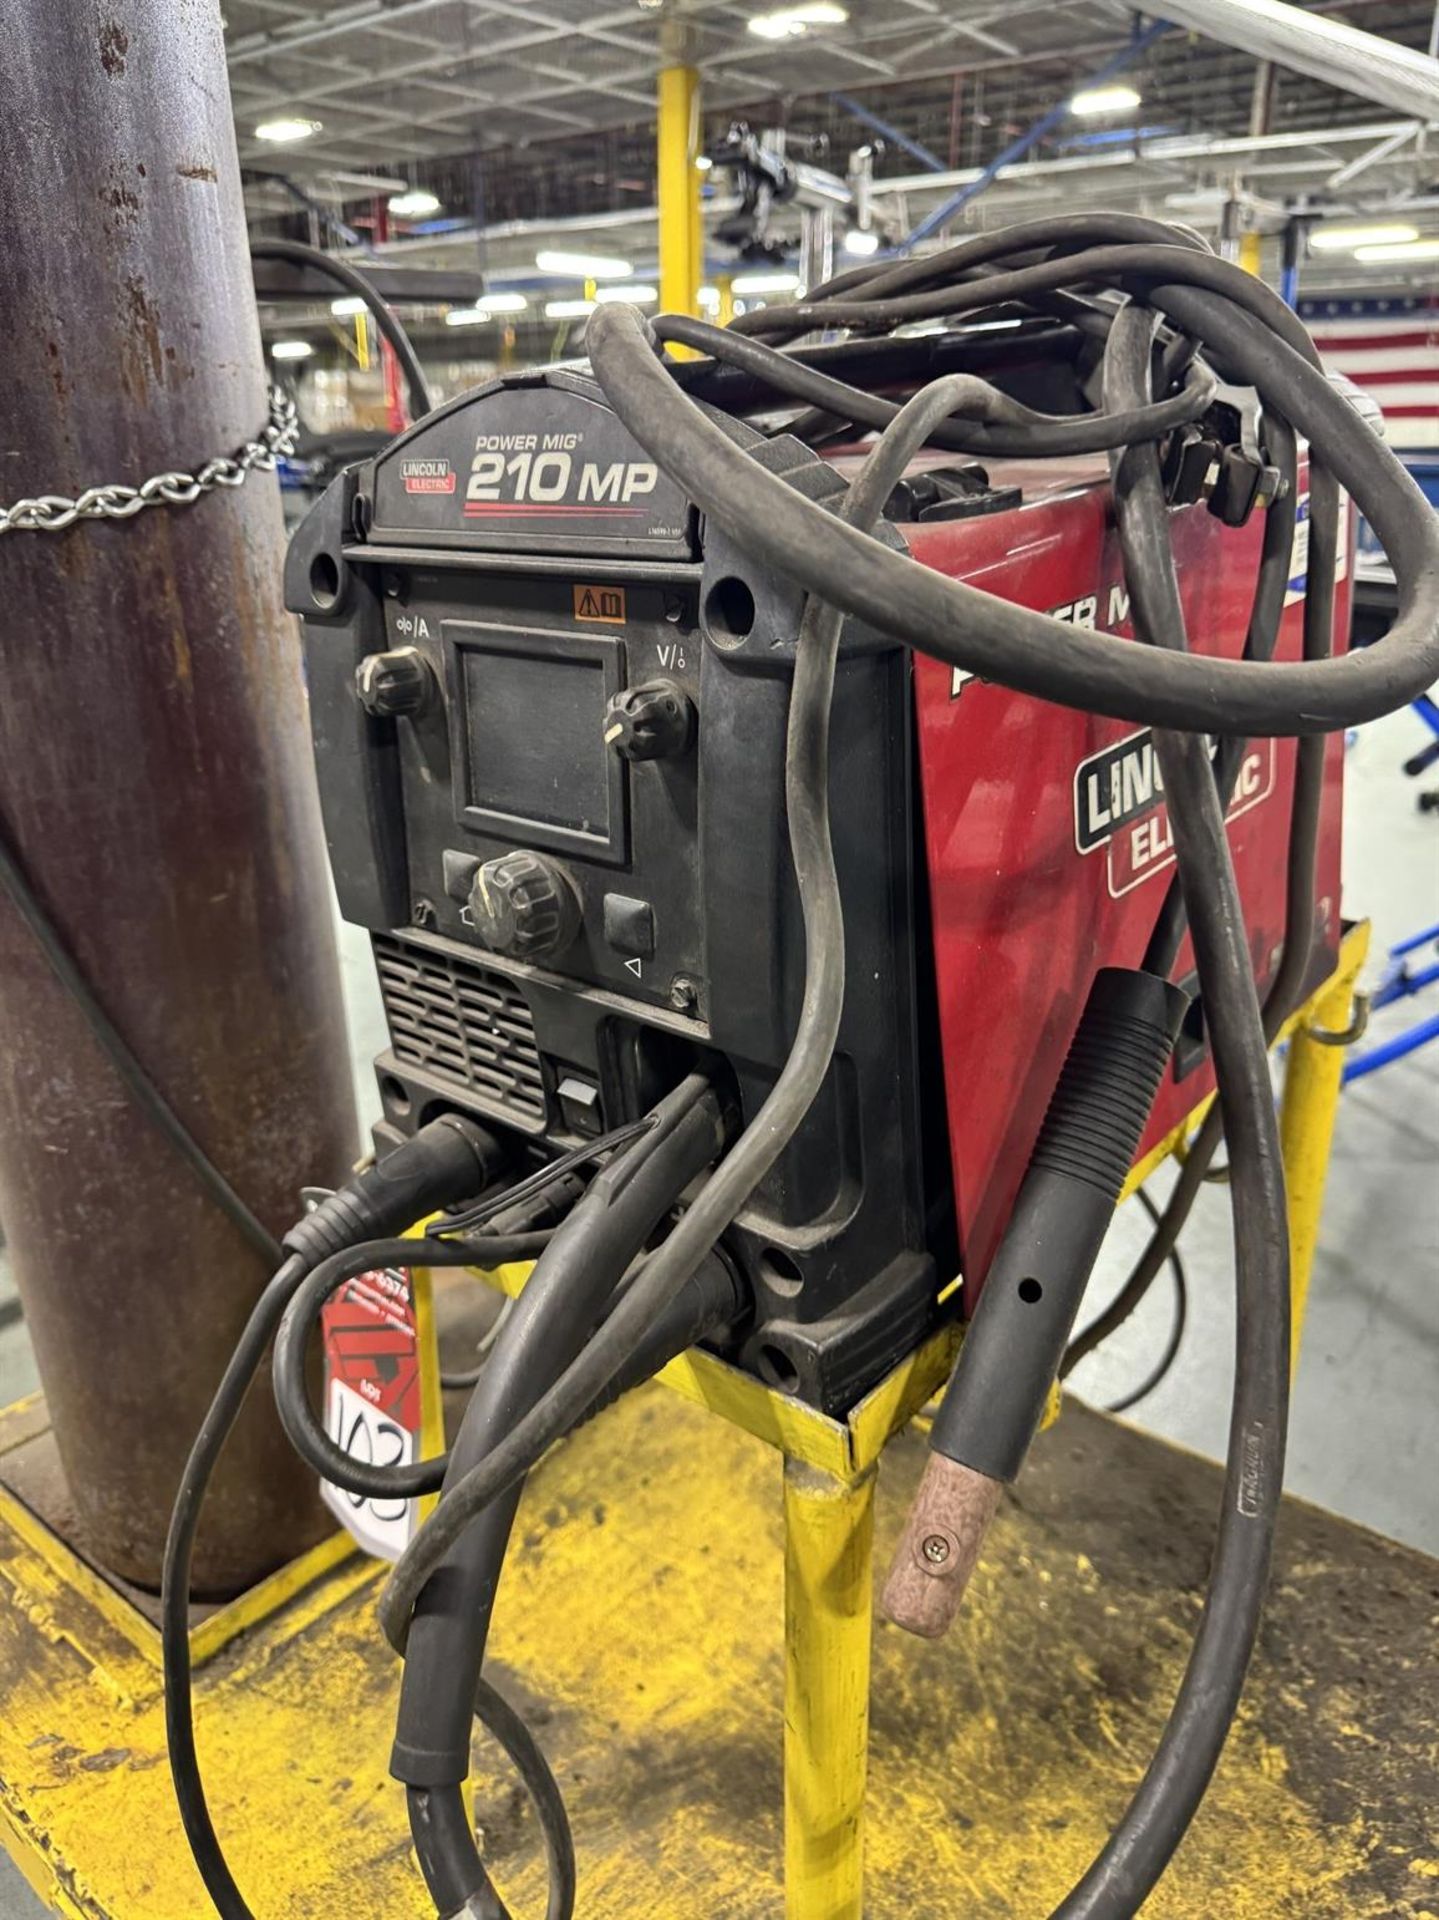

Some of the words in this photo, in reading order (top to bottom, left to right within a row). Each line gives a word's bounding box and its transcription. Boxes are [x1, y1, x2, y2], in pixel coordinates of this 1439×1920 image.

[475, 434, 537, 451] POWER
[402, 463, 447, 477] LINCOLN
[465, 452, 572, 501] 210
[577, 463, 658, 502] MP
[411, 479, 450, 489] ELECTRIC
